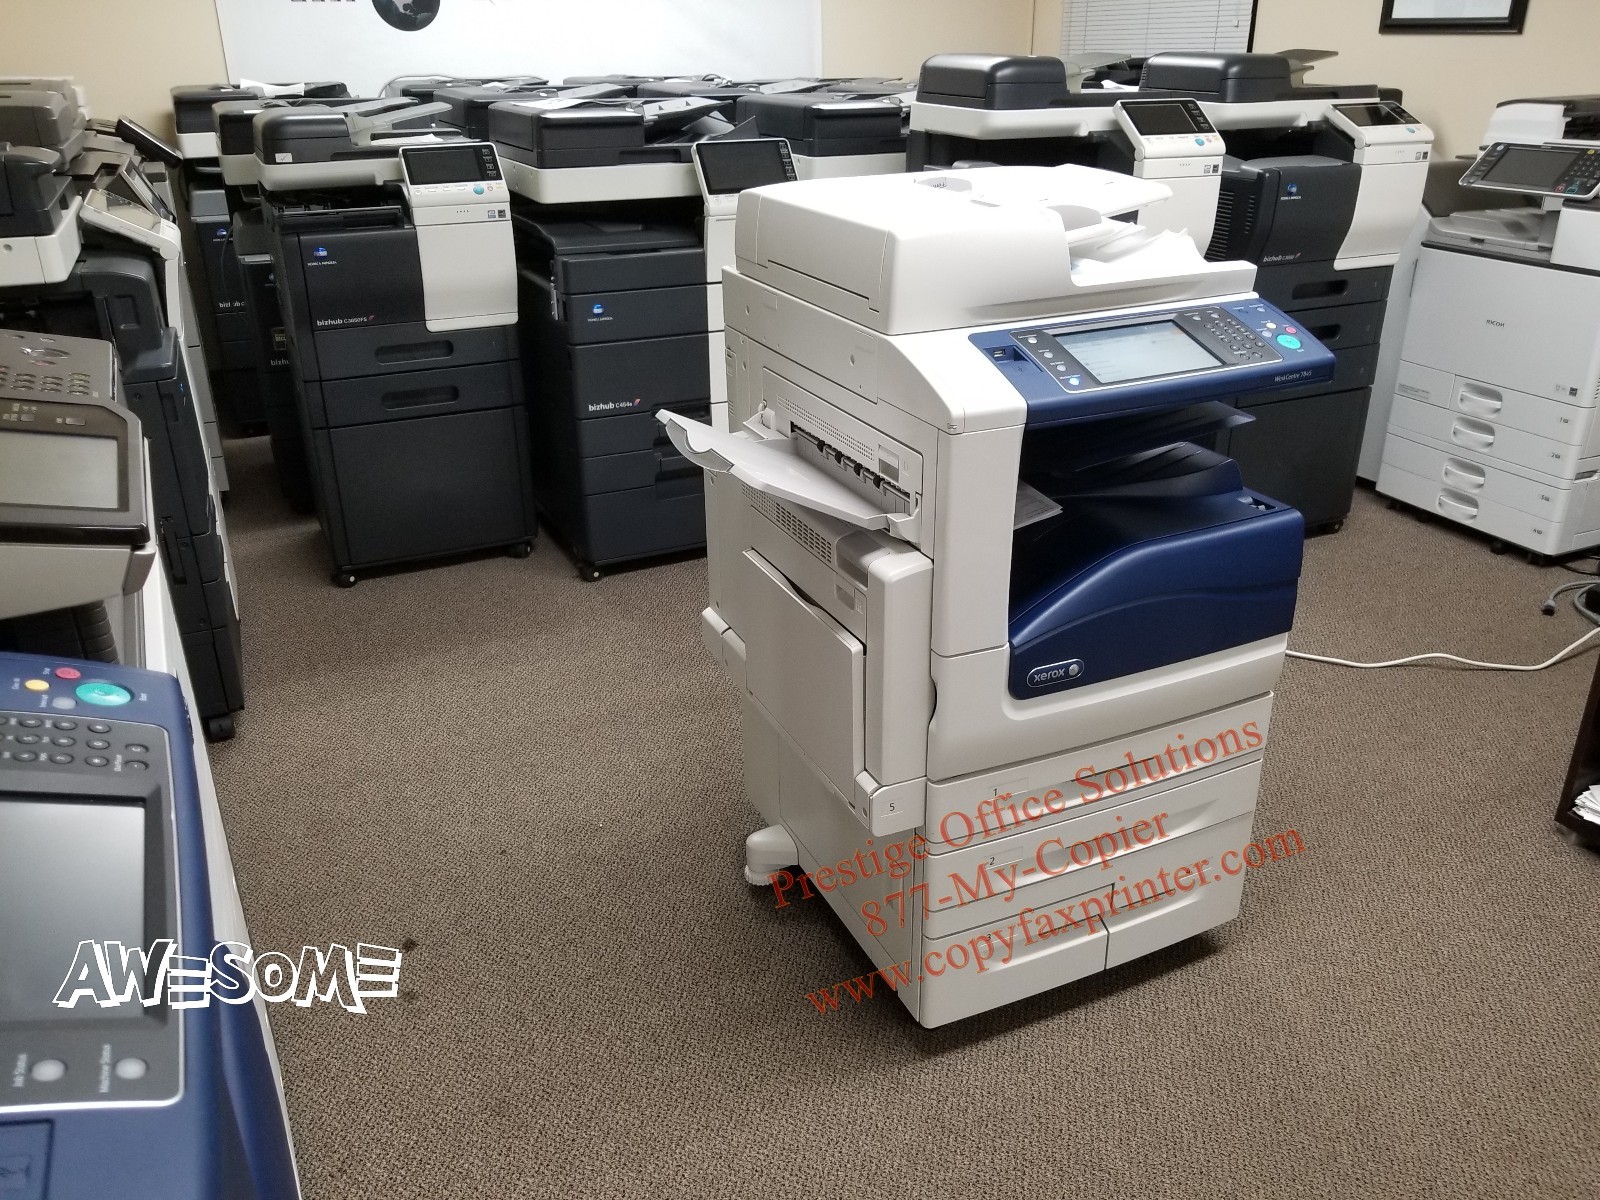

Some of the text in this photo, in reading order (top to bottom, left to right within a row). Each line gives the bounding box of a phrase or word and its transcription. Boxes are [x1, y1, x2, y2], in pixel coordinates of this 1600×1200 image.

[316, 318, 343, 326] bizhub
[1486, 319, 1505, 328] RICOH
[588, 402, 614, 412] bizhub
[1033, 666, 1065, 683] xerox
[889, 802, 895, 812] 5
